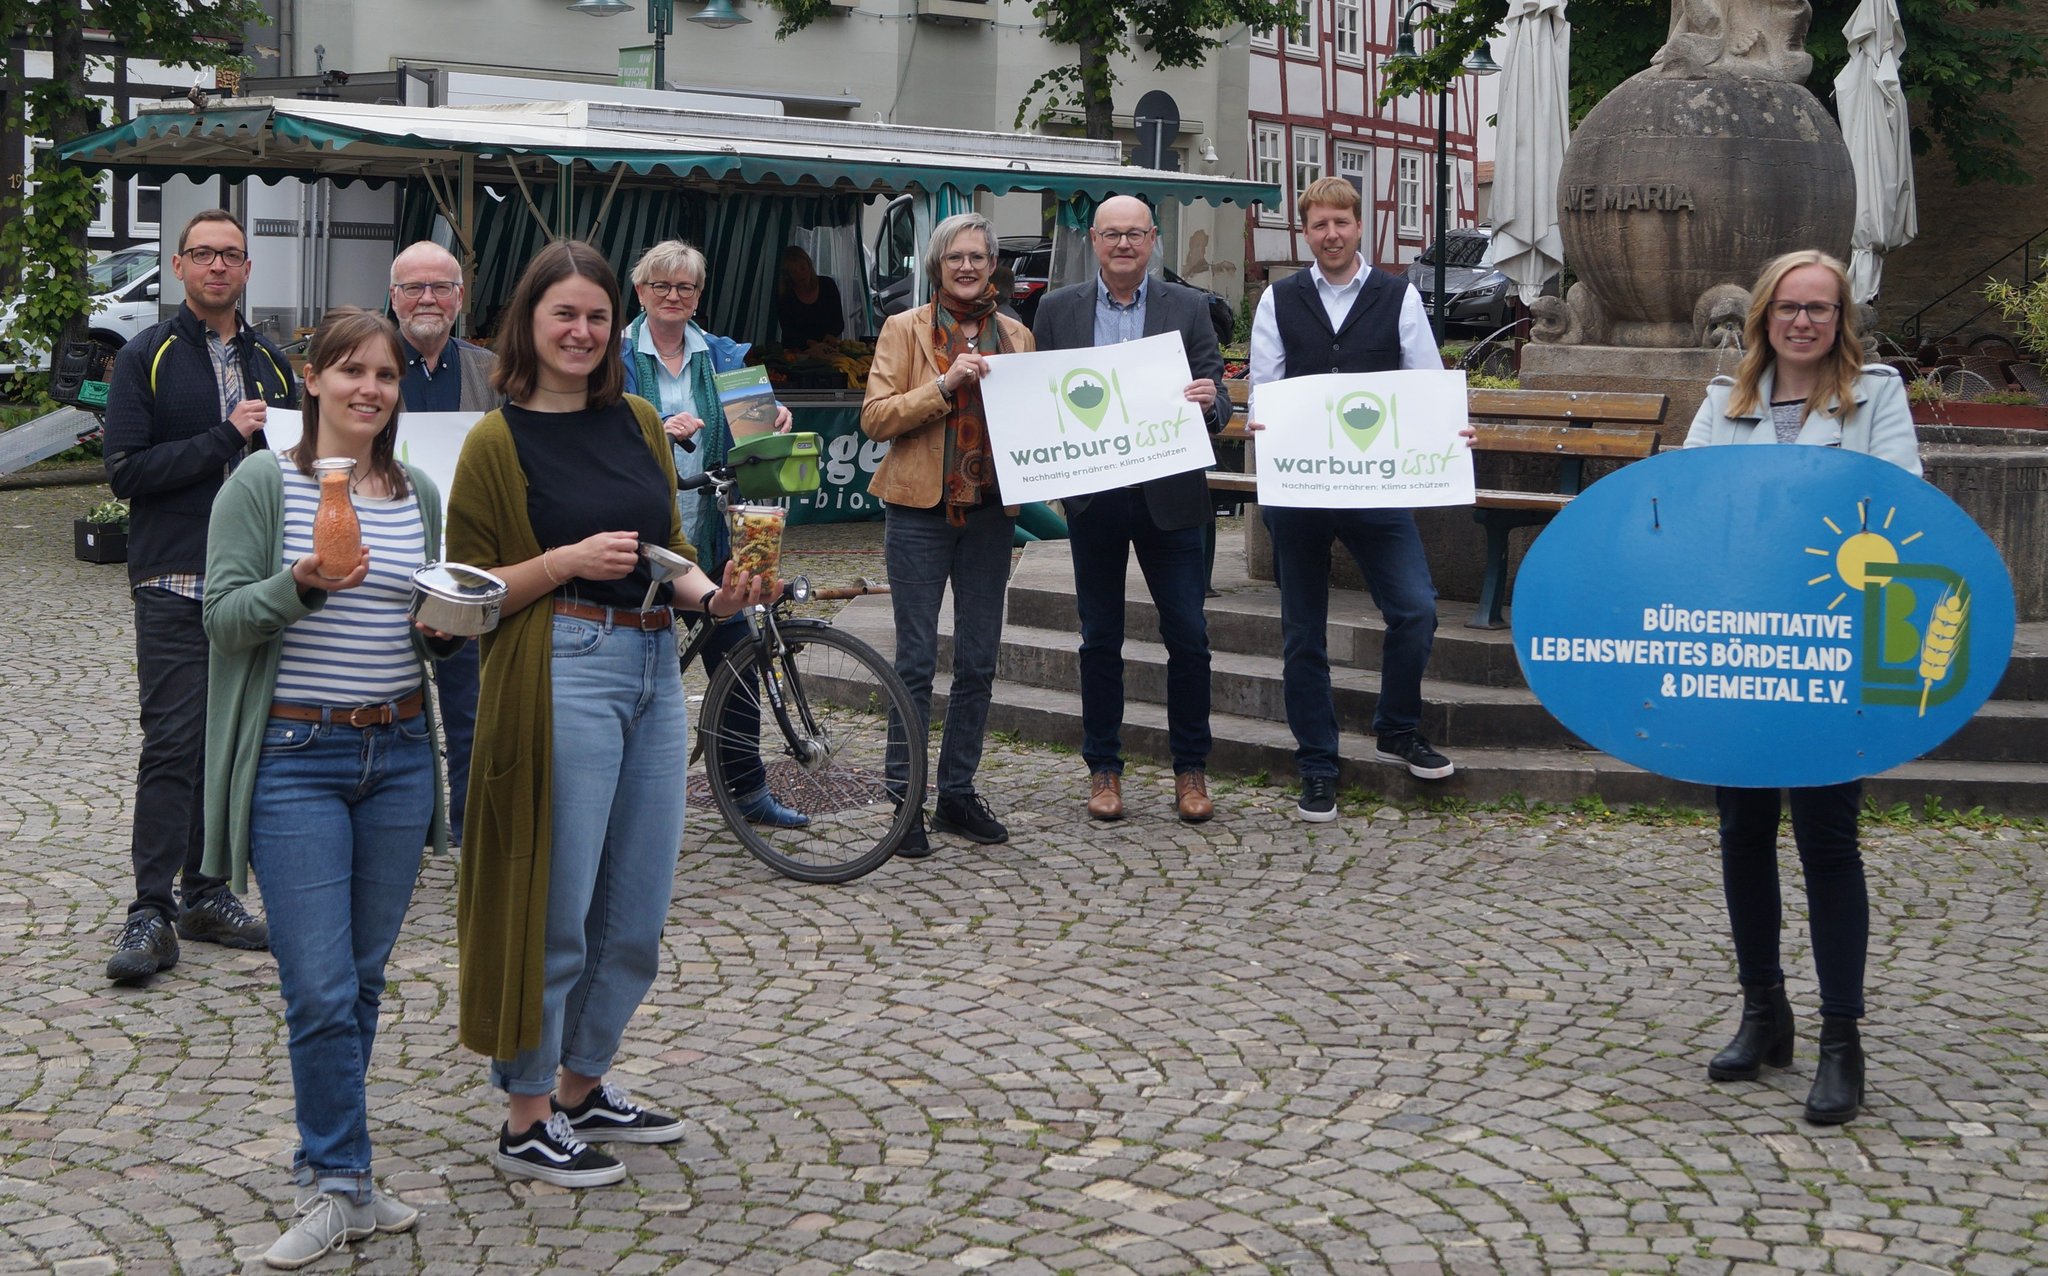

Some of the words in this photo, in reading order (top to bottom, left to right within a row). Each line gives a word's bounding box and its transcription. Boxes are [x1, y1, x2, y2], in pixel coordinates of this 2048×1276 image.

[1561, 184, 1597, 211] AVE
[1601, 184, 1695, 211] MARIA
[758, 376, 769, 385] 43
[1010, 434, 1131, 466] warburg
[1136, 406, 1191, 448] isst
[1022, 470, 1070, 483] Nachhaltig
[1072, 463, 1118, 476] ernähren:
[1120, 457, 1145, 467] Klima
[1147, 447, 1187, 461] schützen
[1273, 456, 1396, 479] warburg
[1401, 443, 1461, 476] isst
[1282, 482, 1330, 492] Nachhaltig
[1333, 483, 1379, 491] ernähren:
[1381, 482, 1407, 490] Klima
[1409, 481, 1450, 490] schützen
[1643, 603, 1852, 639] BÜRGERINITIATIVE
[1531, 637, 1707, 667] LEBENSWERTES
[1711, 638, 1852, 672] BÖRDELAND
[1660, 673, 1677, 698] &
[1681, 673, 1804, 702] DIEMELTAL
[1809, 679, 1848, 704] E.V.
